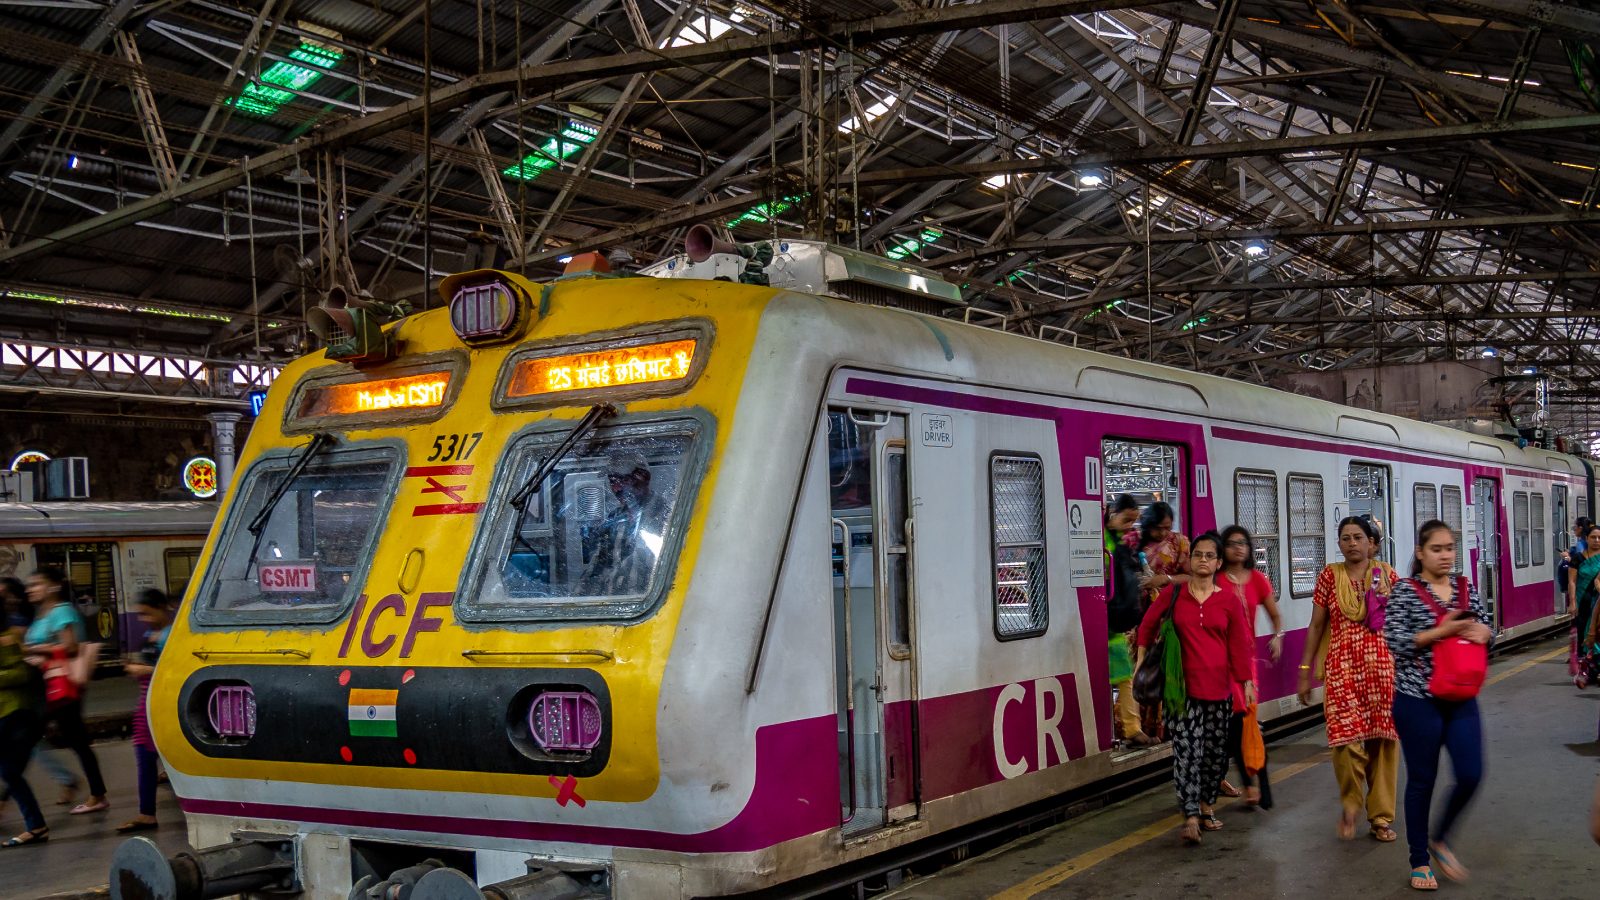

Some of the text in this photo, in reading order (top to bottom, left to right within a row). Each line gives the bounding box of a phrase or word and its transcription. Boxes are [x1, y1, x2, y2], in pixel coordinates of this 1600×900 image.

[408, 381, 446, 405] CSMT
[427, 432, 483, 462] 5317
[924, 431, 950, 442] DRIVER
[262, 568, 311, 588] CSMT
[338, 592, 456, 658] ICF
[993, 676, 1070, 779] CR
